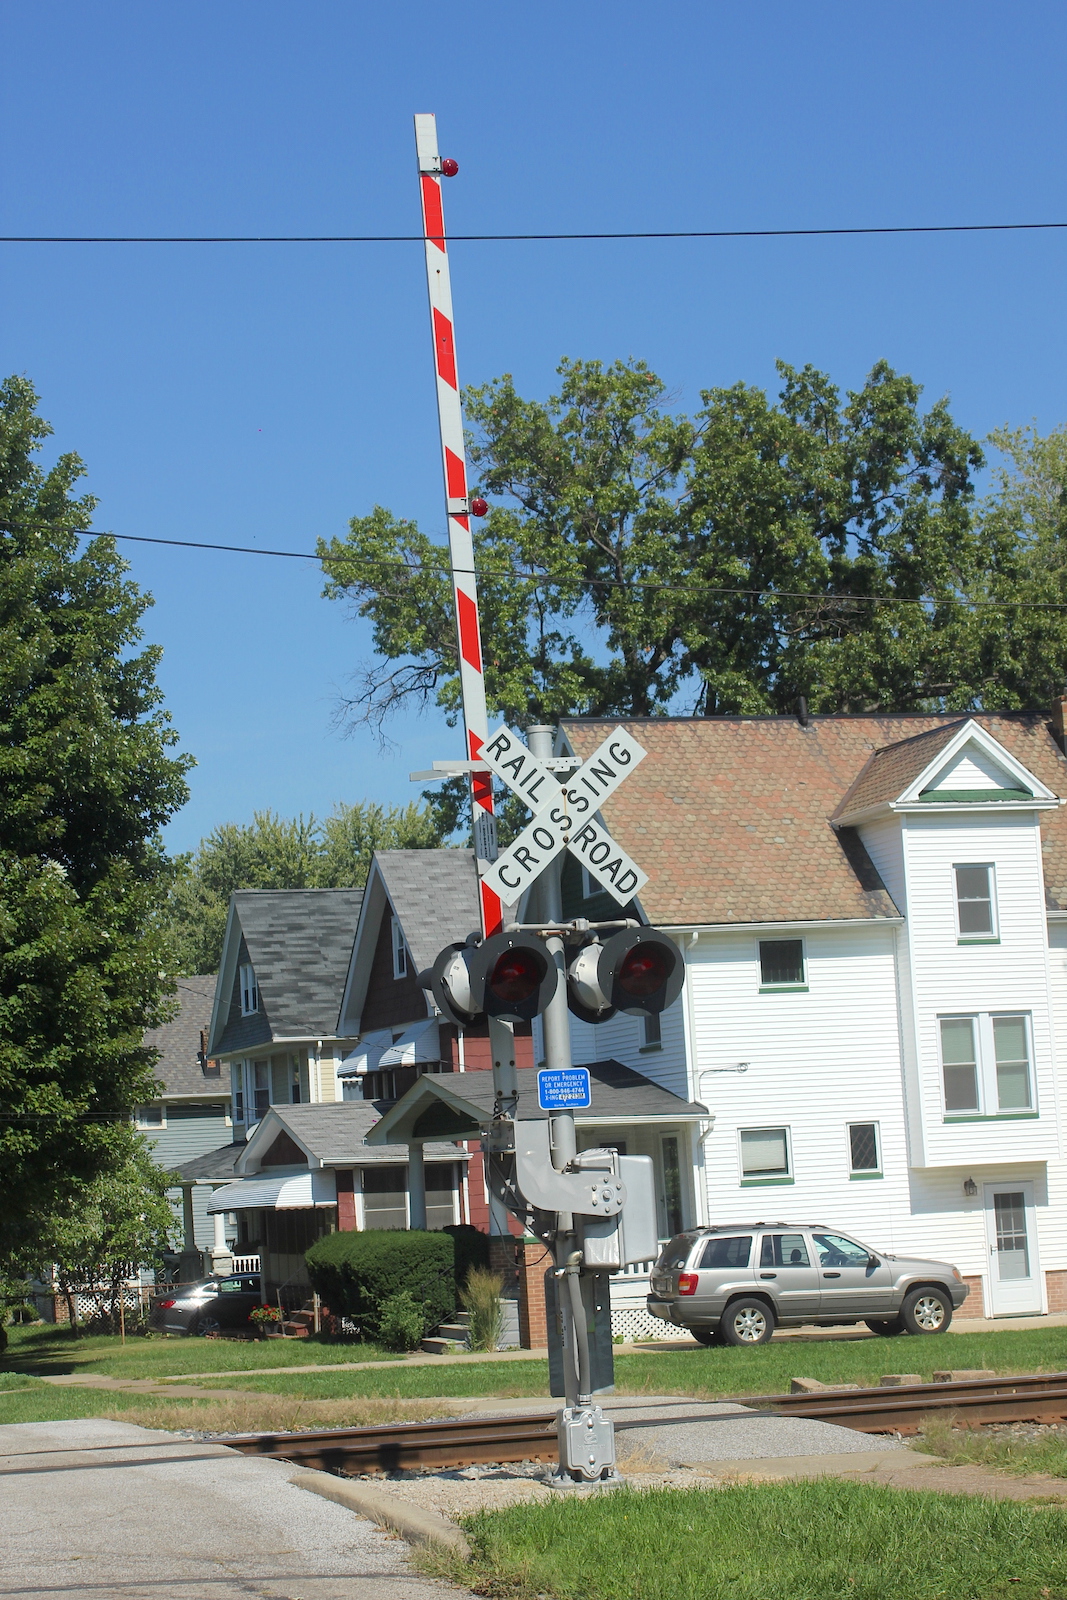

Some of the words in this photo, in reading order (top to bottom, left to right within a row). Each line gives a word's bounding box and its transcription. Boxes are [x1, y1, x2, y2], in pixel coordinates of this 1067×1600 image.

[486, 733, 546, 803] RAIL
[498, 742, 631, 888] CROSSING
[573, 824, 638, 894] ROAD
